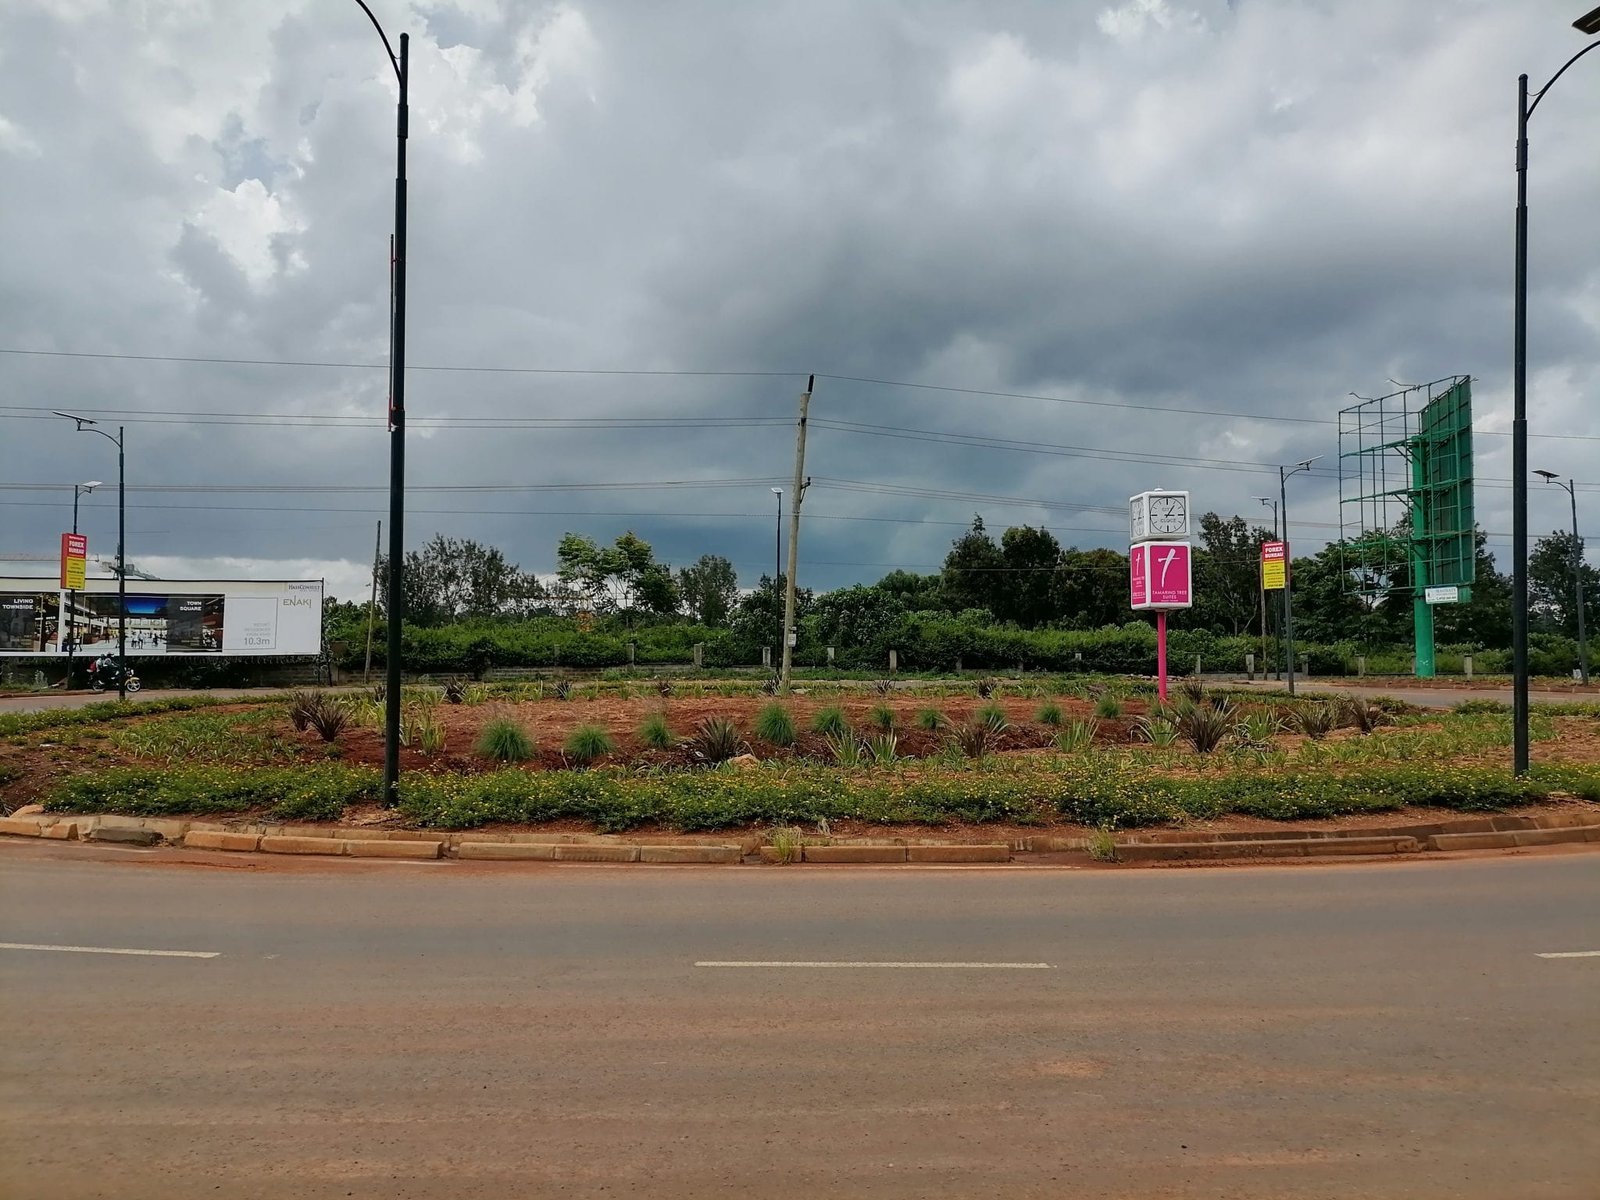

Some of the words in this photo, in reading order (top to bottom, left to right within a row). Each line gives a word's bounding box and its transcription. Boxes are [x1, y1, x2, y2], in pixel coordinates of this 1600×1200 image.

[68, 540, 85, 548] FOREX
[282, 595, 312, 608] ENAKI
[244, 637, 270, 646] 10.3m
